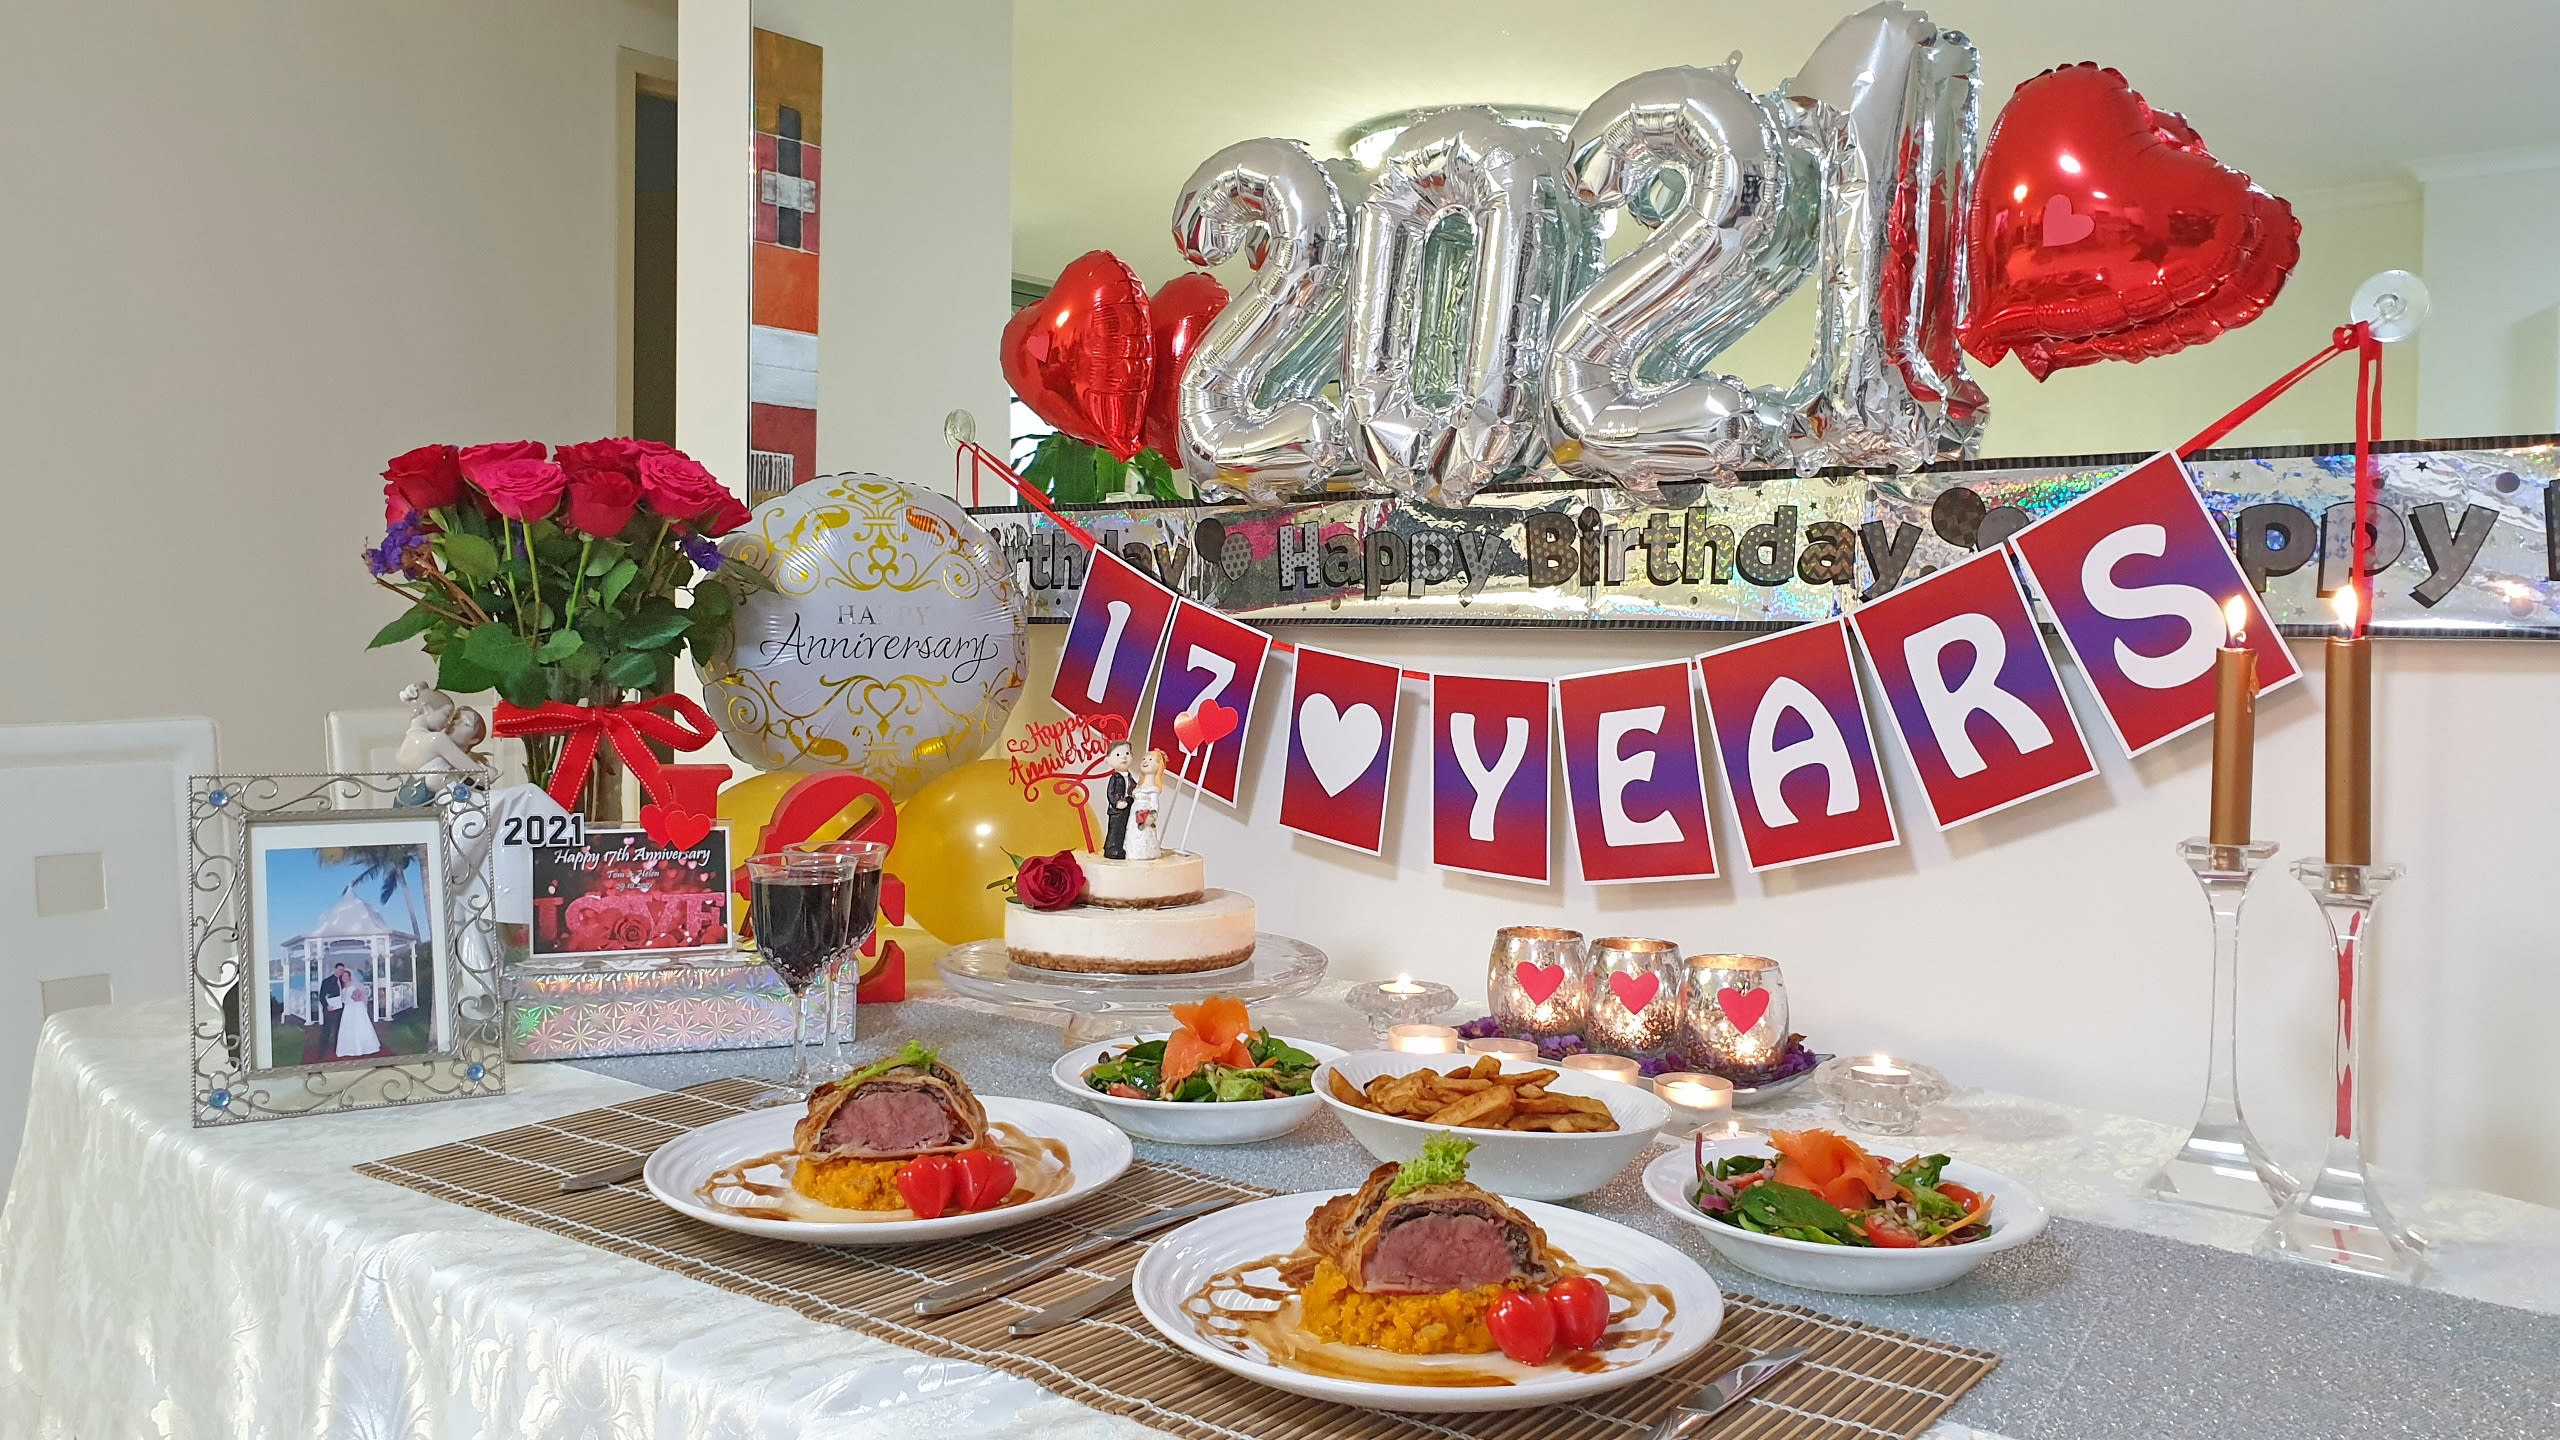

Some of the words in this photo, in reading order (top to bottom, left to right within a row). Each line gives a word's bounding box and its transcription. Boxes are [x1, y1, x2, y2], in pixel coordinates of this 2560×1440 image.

[1173, 1, 1948, 502] 2021
[1277, 520, 1500, 608] Happy
[1526, 506, 1924, 599] Birthday
[2214, 502, 2500, 608] ppy
[760, 612, 999, 683] Anniversary
[1086, 600, 1237, 757] 17
[1450, 524, 2228, 847] YEARS
[1009, 731, 1121, 786] Anniversa
[503, 813, 584, 847] 2021
[554, 849, 600, 871] Happy
[603, 845, 630, 867] 17th
[633, 847, 711, 867] Anniversary
